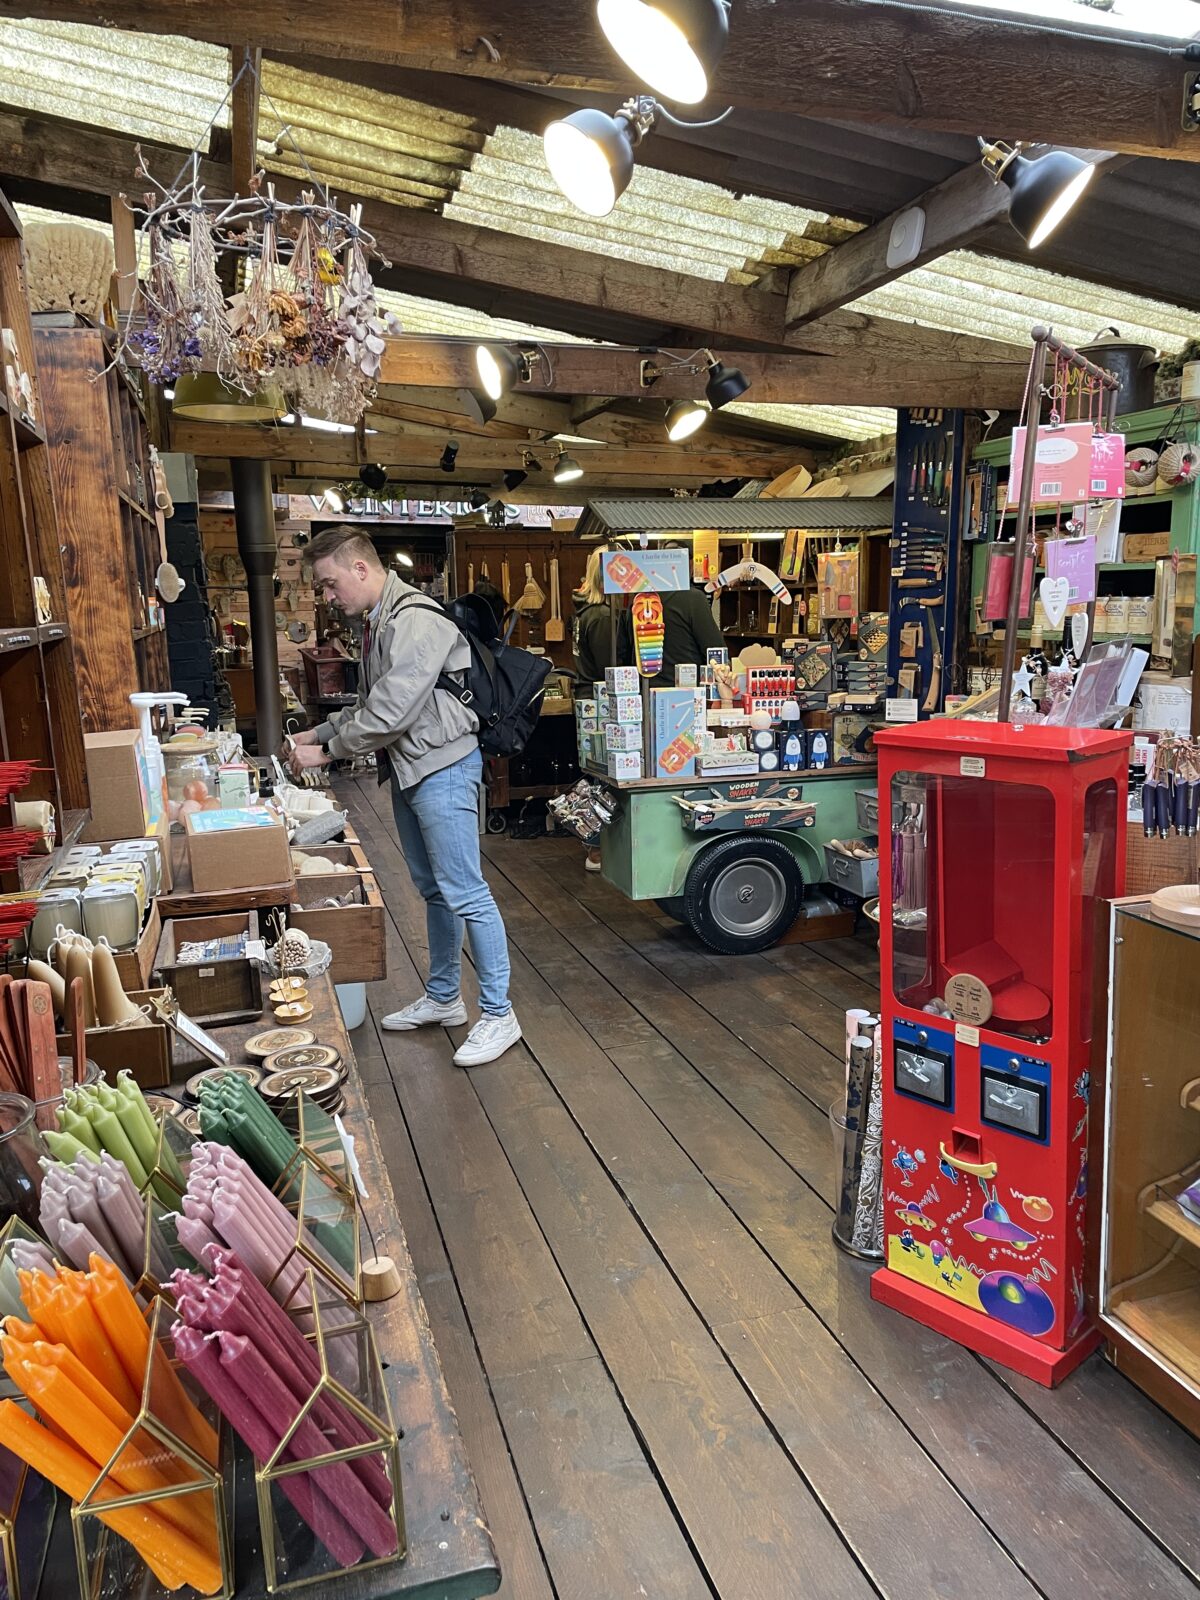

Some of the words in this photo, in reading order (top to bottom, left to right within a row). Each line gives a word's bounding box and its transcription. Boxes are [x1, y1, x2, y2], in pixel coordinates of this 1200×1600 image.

[729, 781, 760, 791] WOODEN
[729, 787, 758, 798] SNAKES
[744, 812, 771, 820] WOODEN
[744, 817, 769, 826] SNAKES
